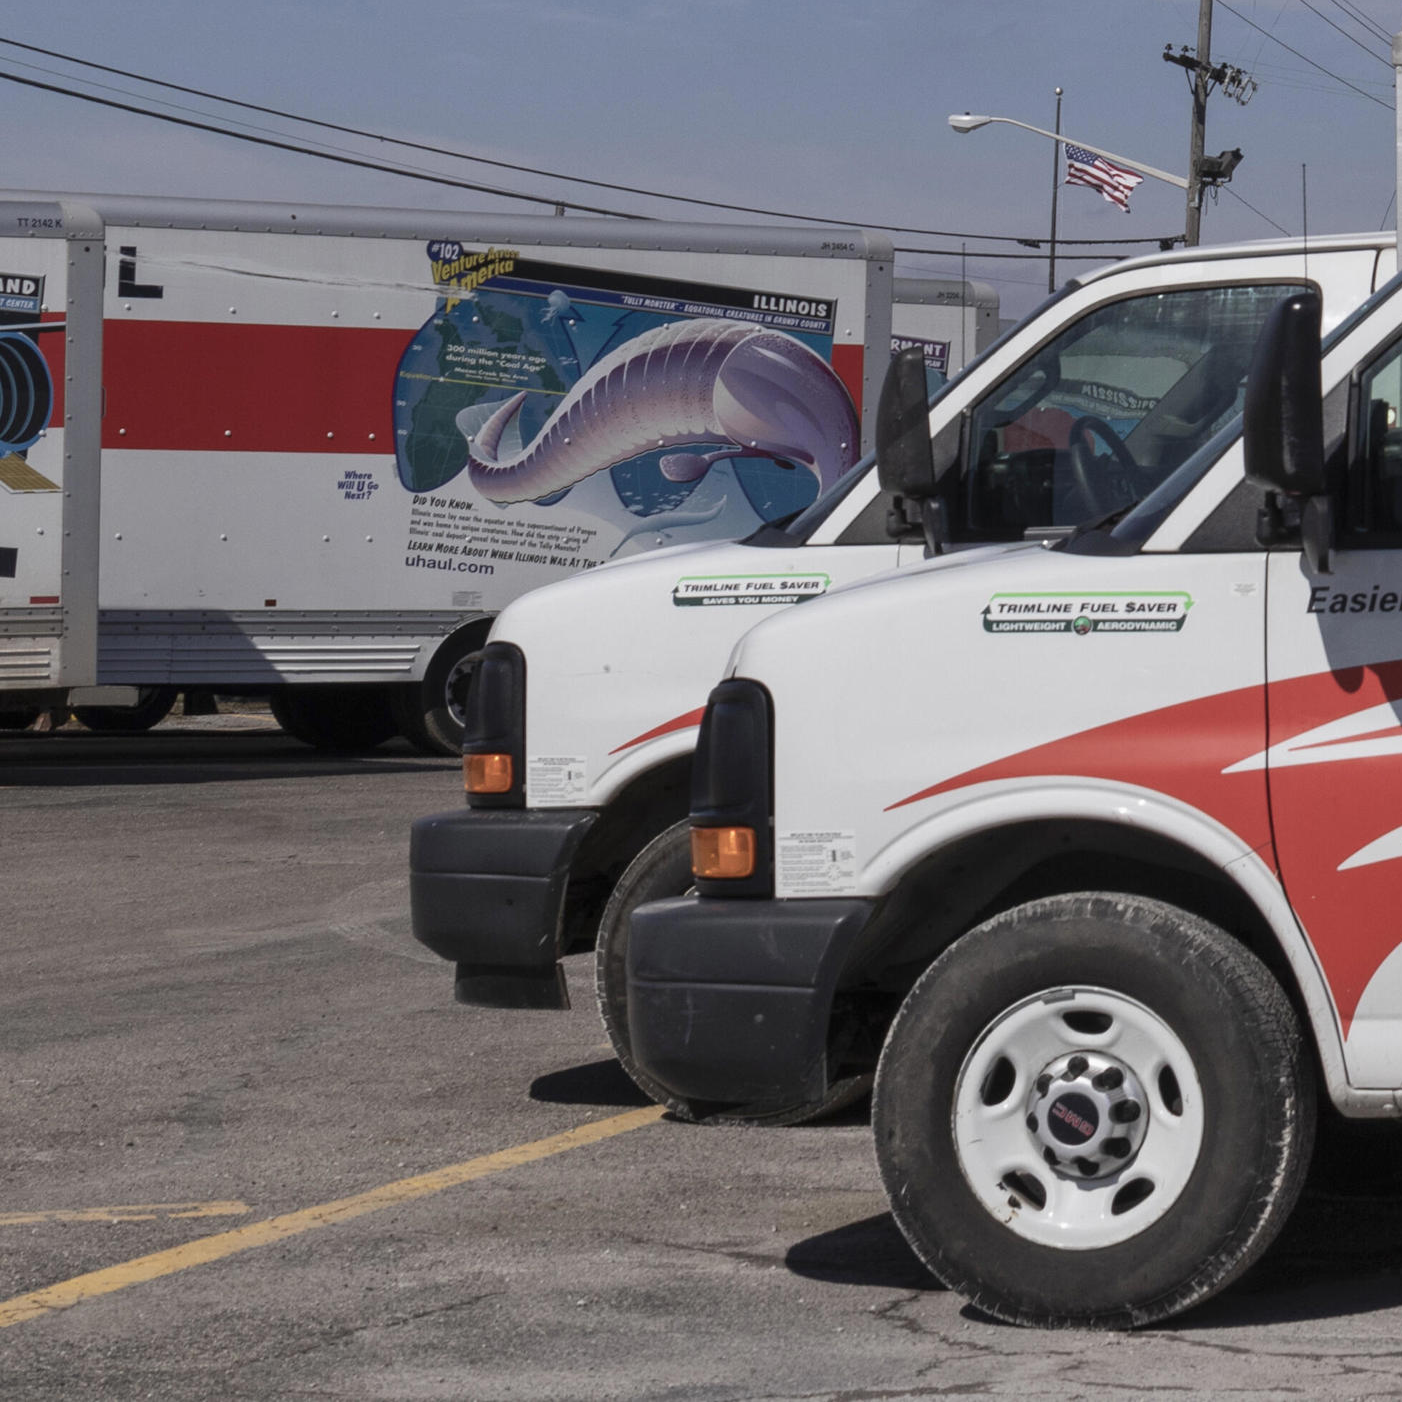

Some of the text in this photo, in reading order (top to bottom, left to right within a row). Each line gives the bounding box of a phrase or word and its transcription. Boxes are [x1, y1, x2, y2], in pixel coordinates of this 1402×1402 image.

[17, 218, 63, 228] TT 2142 K
[431, 253, 486, 284] Venture
[0, 277, 36, 296] ND
[753, 294, 828, 317] ILLINOIS
[344, 470, 372, 480] Where
[337, 480, 379, 492] Will U Go
[405, 555, 495, 575] uhaul.com
[702, 595, 800, 605] SAVES YOU MONEY
[992, 621, 1178, 631] LIGHTWEIGHT AERODYNAMIC
